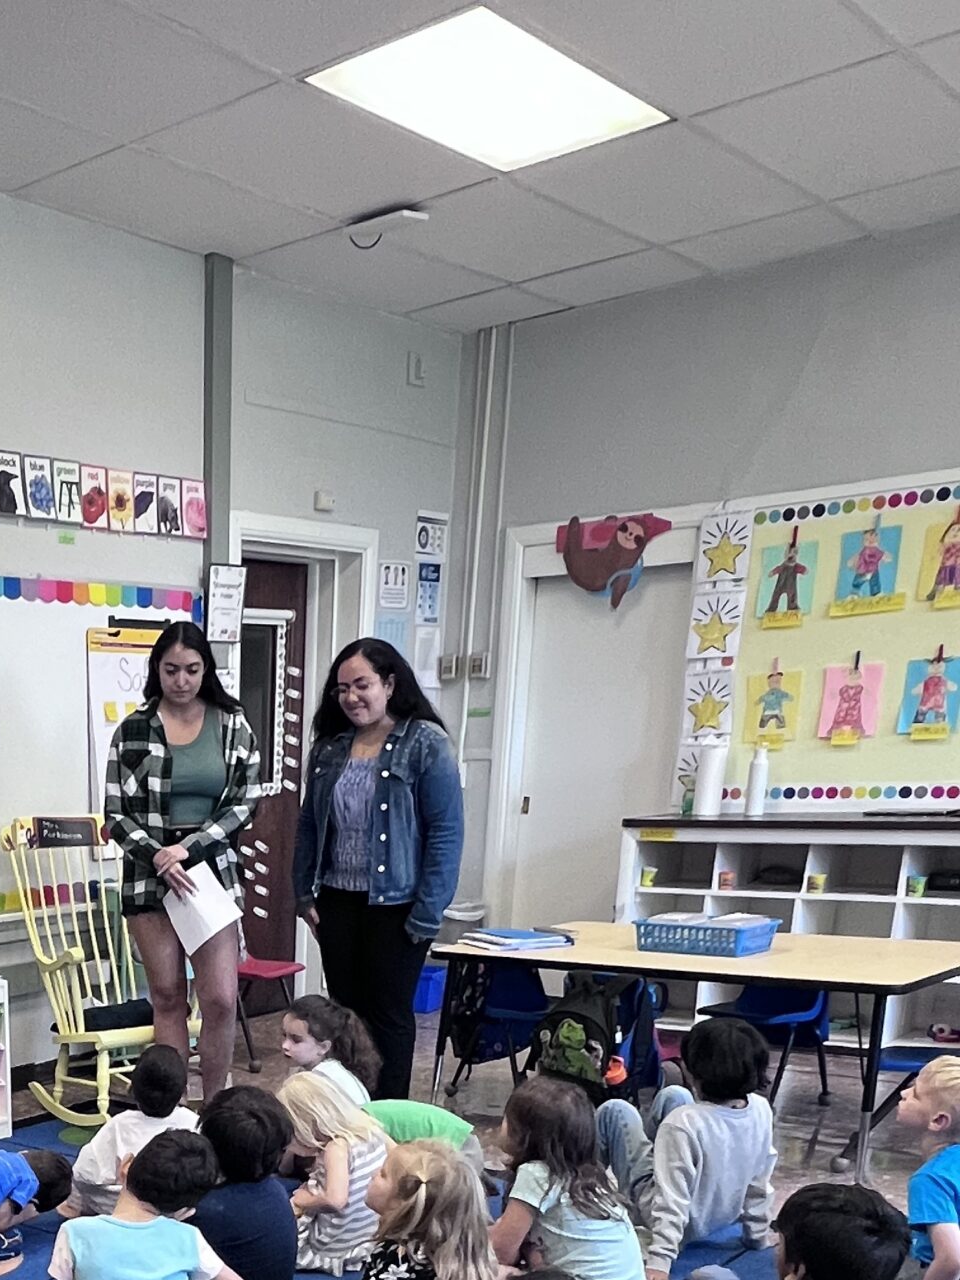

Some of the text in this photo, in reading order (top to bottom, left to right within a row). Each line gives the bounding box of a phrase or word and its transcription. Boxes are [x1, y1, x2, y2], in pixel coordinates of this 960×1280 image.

[30, 461, 45, 472] blue
[56, 466, 76, 477] green
[88, 472, 99, 481] red
[136, 479, 155, 489] purple
